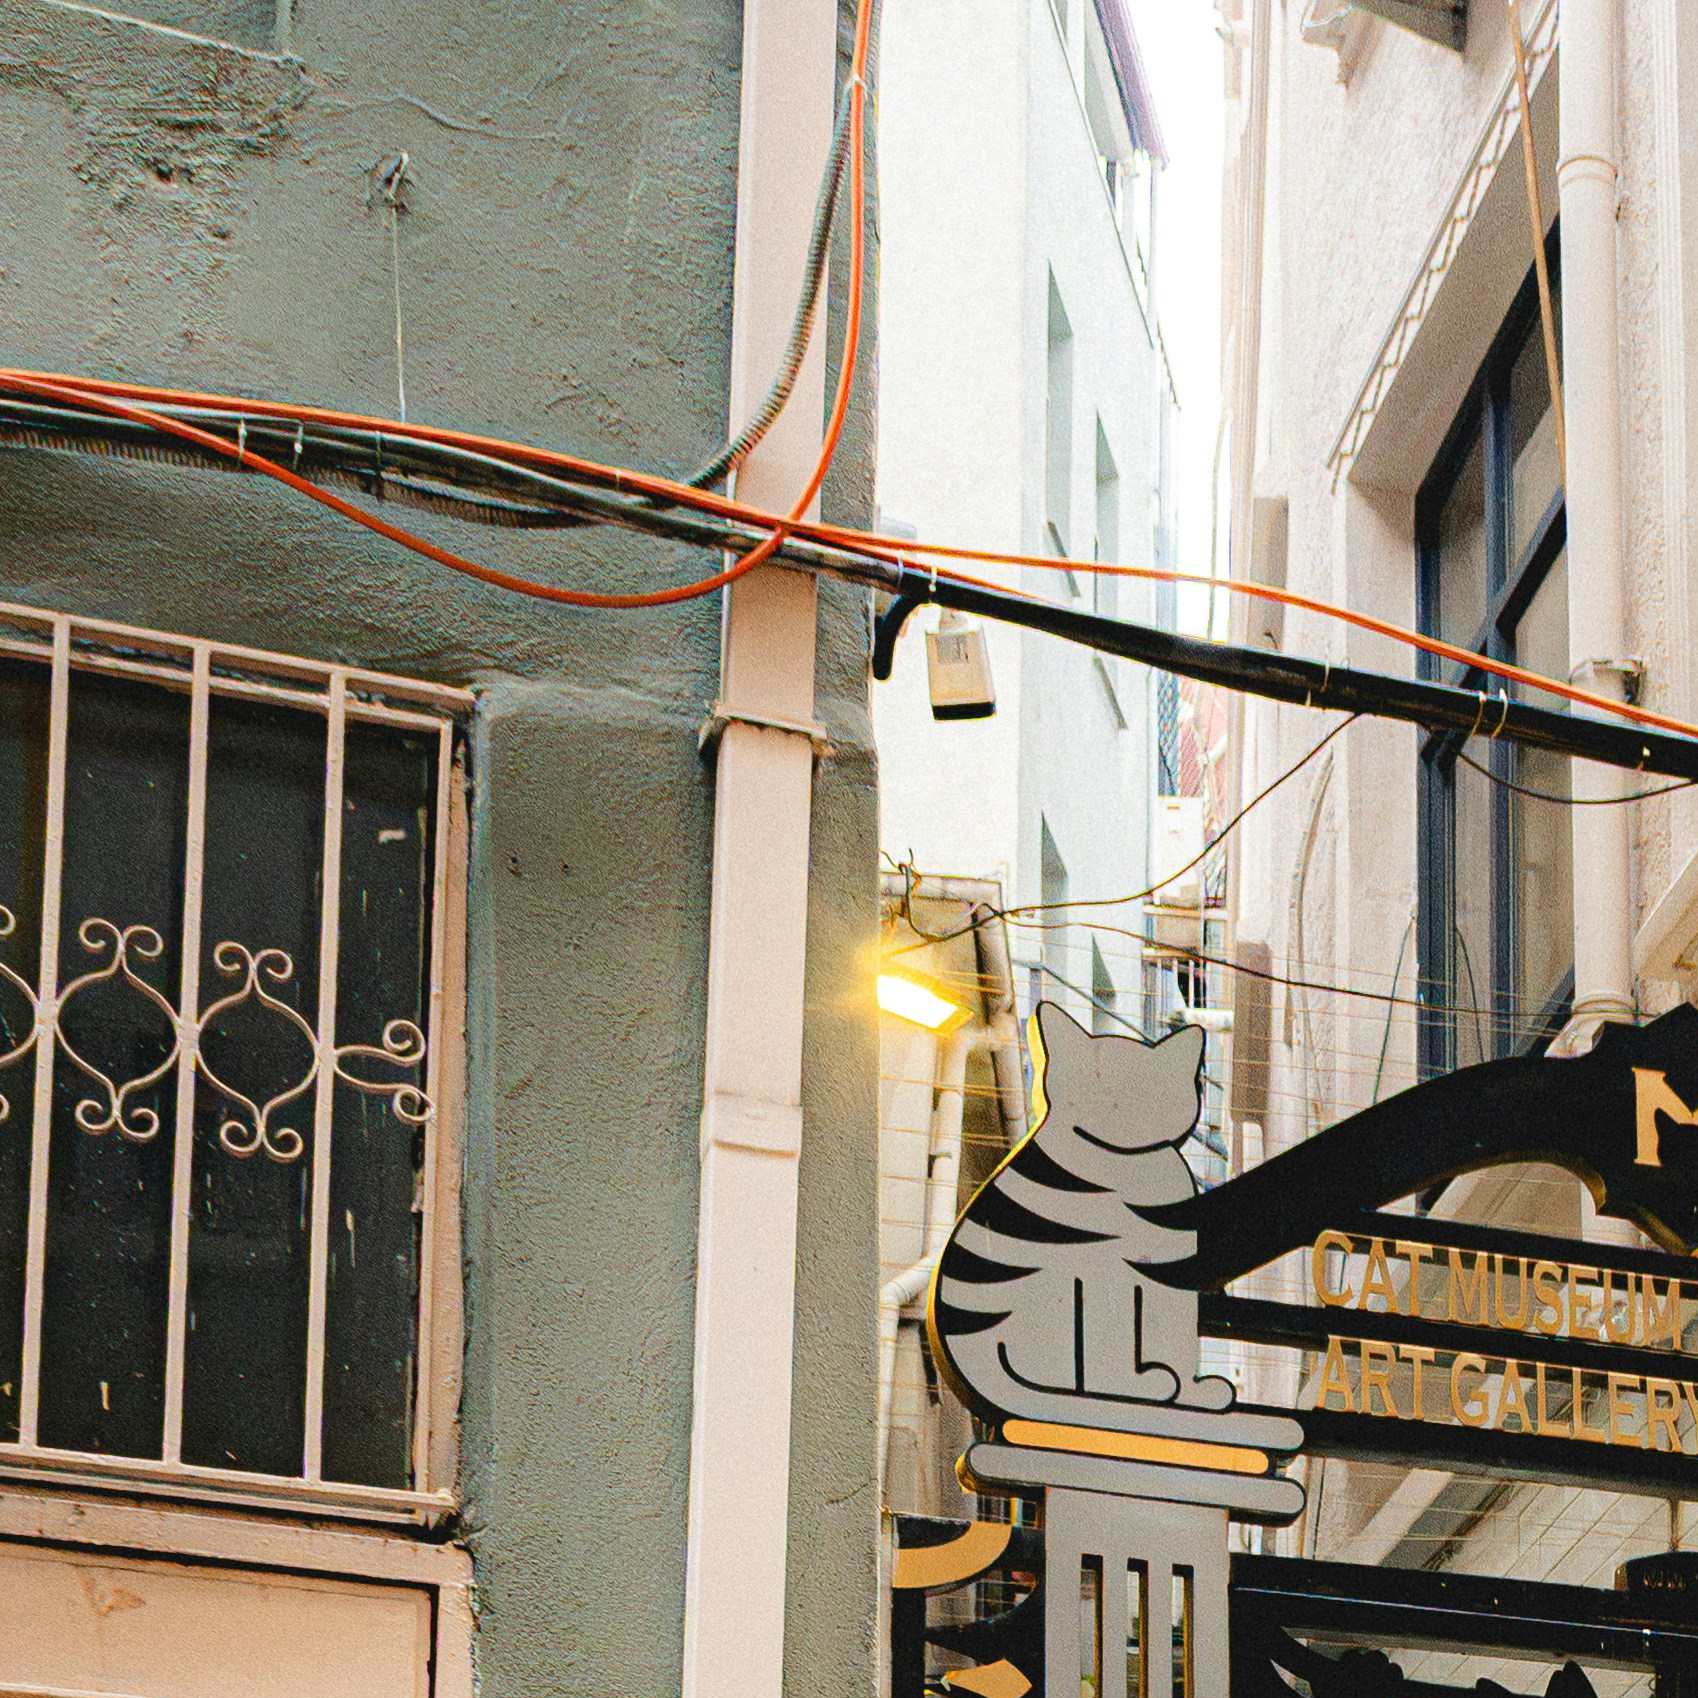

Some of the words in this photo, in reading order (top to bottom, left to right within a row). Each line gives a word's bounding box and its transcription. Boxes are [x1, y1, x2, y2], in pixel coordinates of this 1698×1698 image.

[1312, 1230, 1438, 1315] CAT
[1448, 1246, 1680, 1351] MUSEUM
[1317, 1335, 1437, 1419] ART
